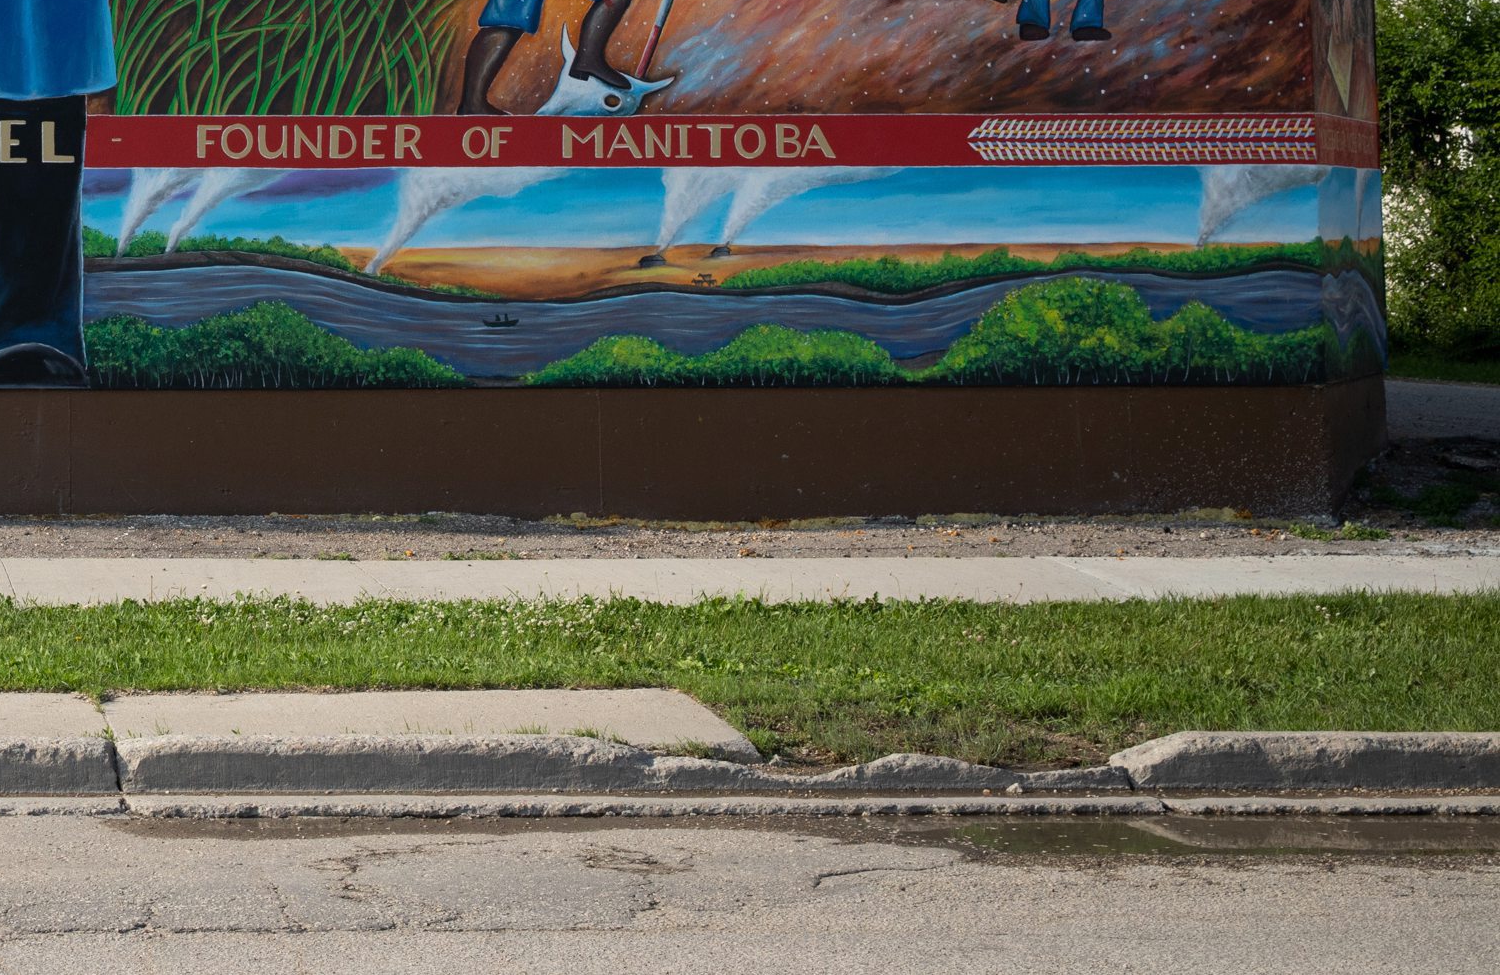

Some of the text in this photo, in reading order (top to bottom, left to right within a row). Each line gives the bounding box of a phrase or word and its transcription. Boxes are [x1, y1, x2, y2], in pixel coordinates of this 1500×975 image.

[196, 124, 423, 160] FOUNDER
[461, 126, 514, 159] OF
[561, 123, 837, 161] MANITOBA
